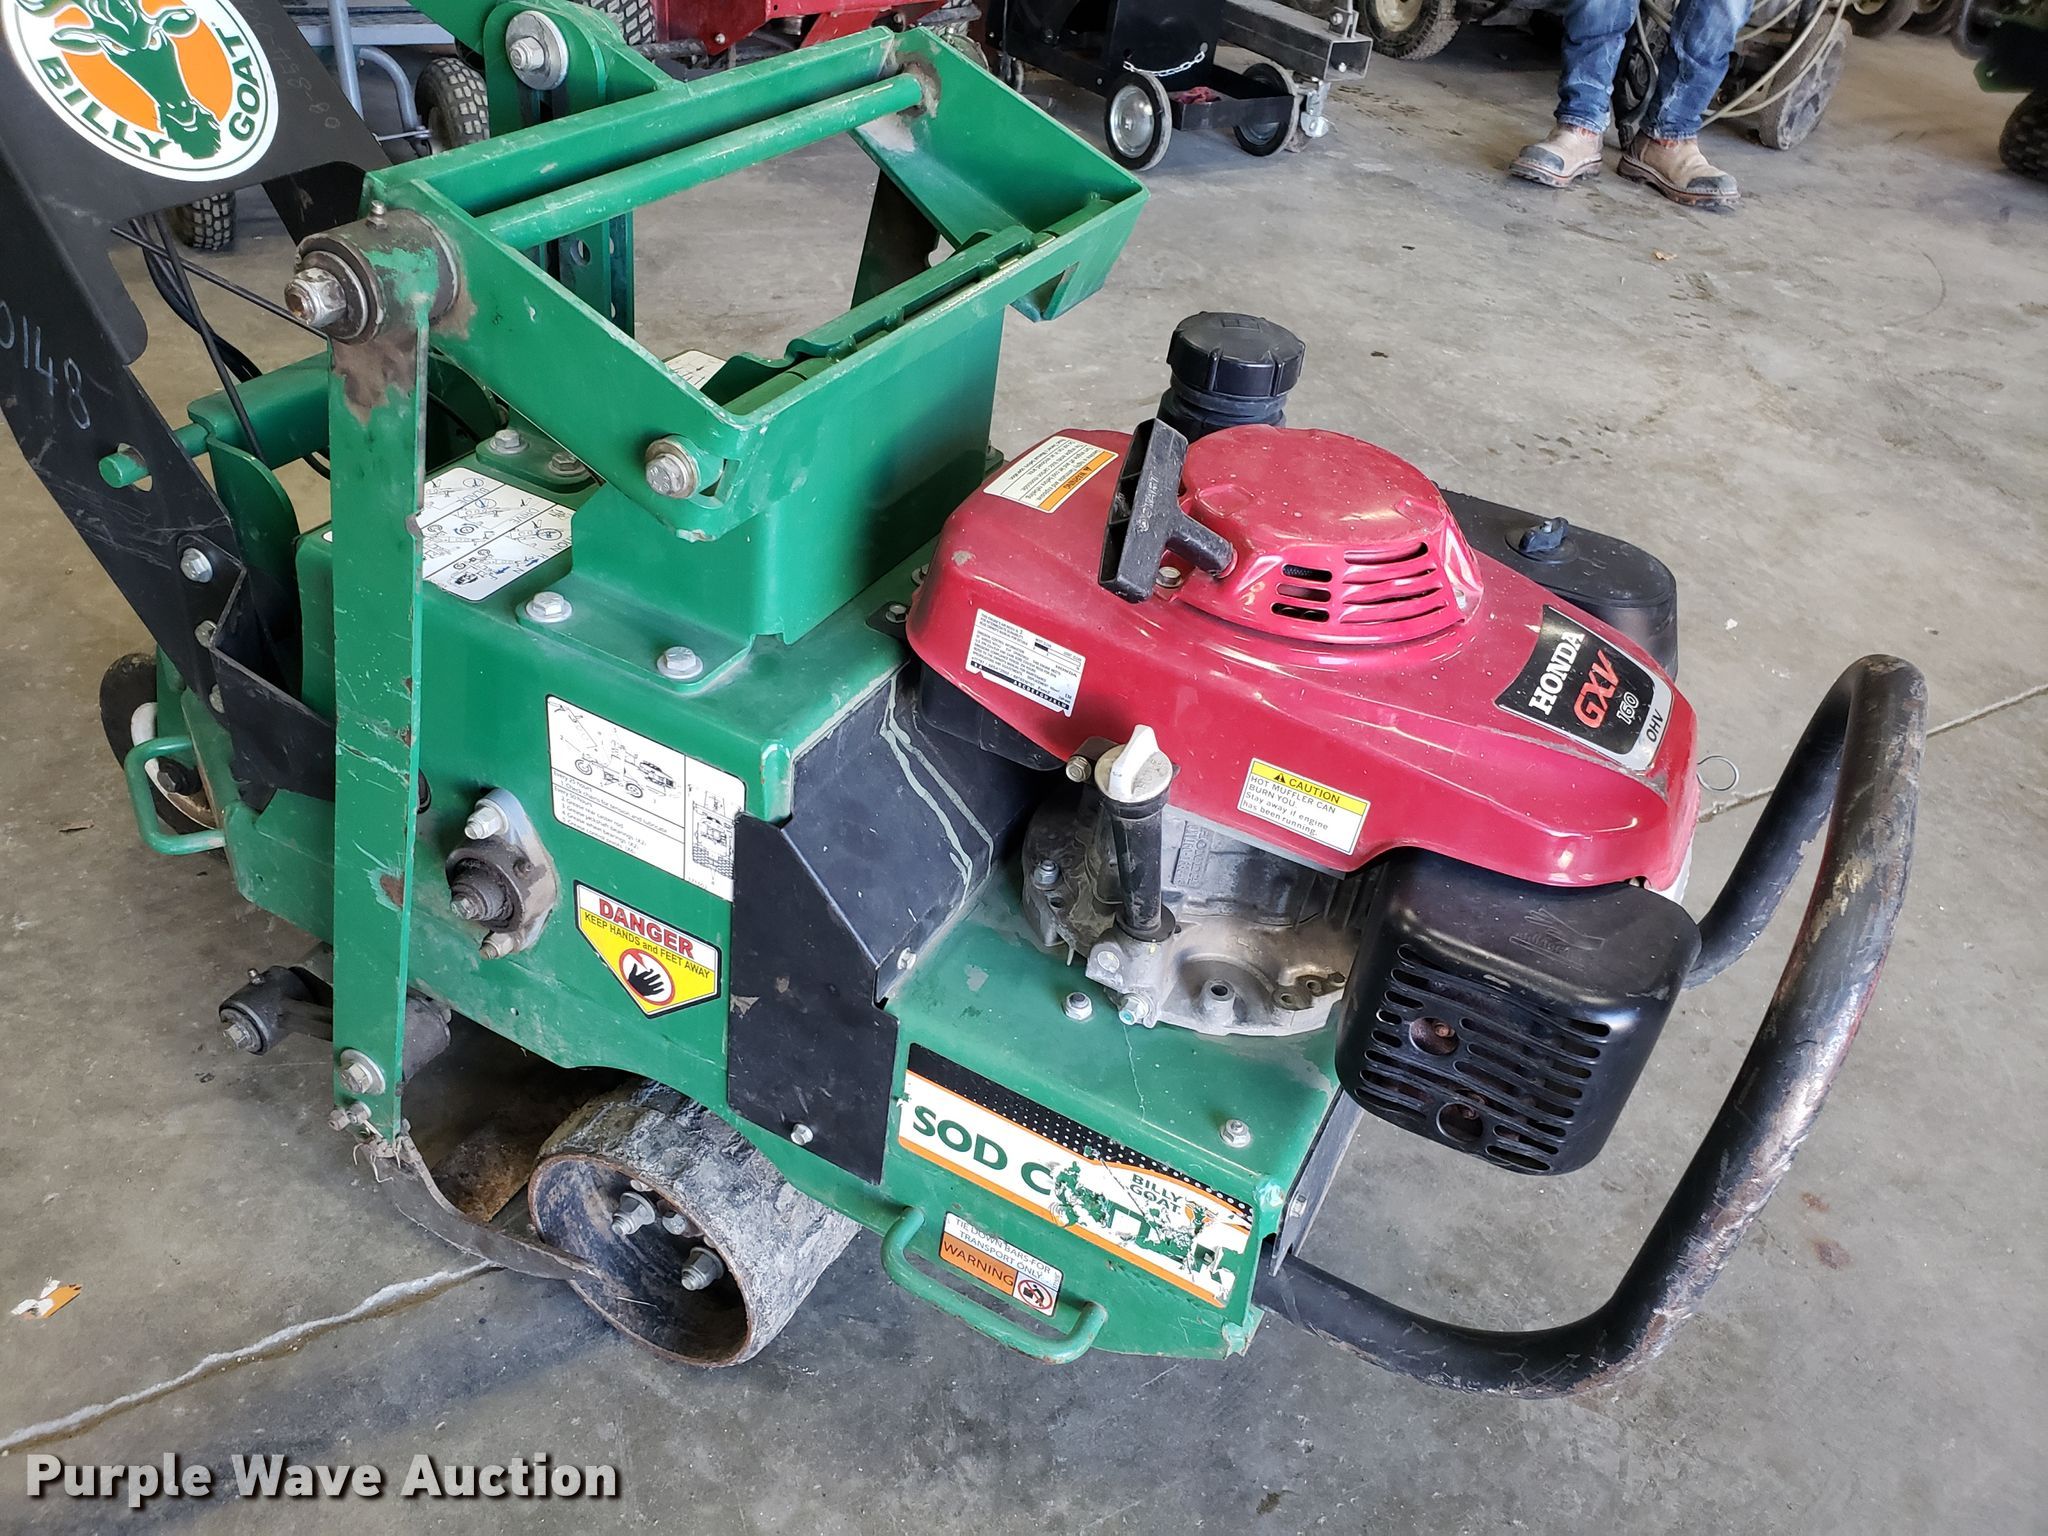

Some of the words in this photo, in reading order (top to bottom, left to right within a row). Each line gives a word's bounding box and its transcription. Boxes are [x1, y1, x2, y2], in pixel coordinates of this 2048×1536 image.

[38, 56, 172, 159] BILLY
[215, 26, 261, 141] GOAT
[508, 507, 539, 525] DRIVE
[1528, 631, 1586, 715] HONDA
[1573, 649, 1620, 729] GXV
[1616, 691, 1639, 725] 160
[1646, 709, 1664, 743] OHV
[1248, 784, 1275, 799] BURN
[1277, 794, 1298, 808] YOU.
[1250, 776, 1269, 787] HOT
[1271, 783, 1314, 805] MUFFLER
[1316, 801, 1336, 814] CAN
[1289, 778, 1341, 804] CAUTION
[1242, 800, 1258, 811] has
[1259, 806, 1281, 820] been
[1282, 816, 1318, 836] running.
[1245, 792, 1263, 804] Stay
[1266, 801, 1288, 815] away
[1298, 814, 1329, 830] engine
[584, 912, 608, 929] KEEP
[610, 925, 641, 946] HANDS
[642, 941, 658, 954] and
[660, 949, 683, 966] FEET
[684, 961, 711, 979] AWAY
[599, 898, 694, 959] DANGER
[912, 1106, 1009, 1171] SOD
[1132, 1174, 1183, 1202] BILLY
[956, 1218, 970, 1231] TIE
[971, 1226, 1002, 1247] DOWN
[943, 1241, 1014, 1287] WARNING
[960, 1231, 1016, 1265] TRANSPORT
[1016, 1261, 1043, 1279] ONLY
